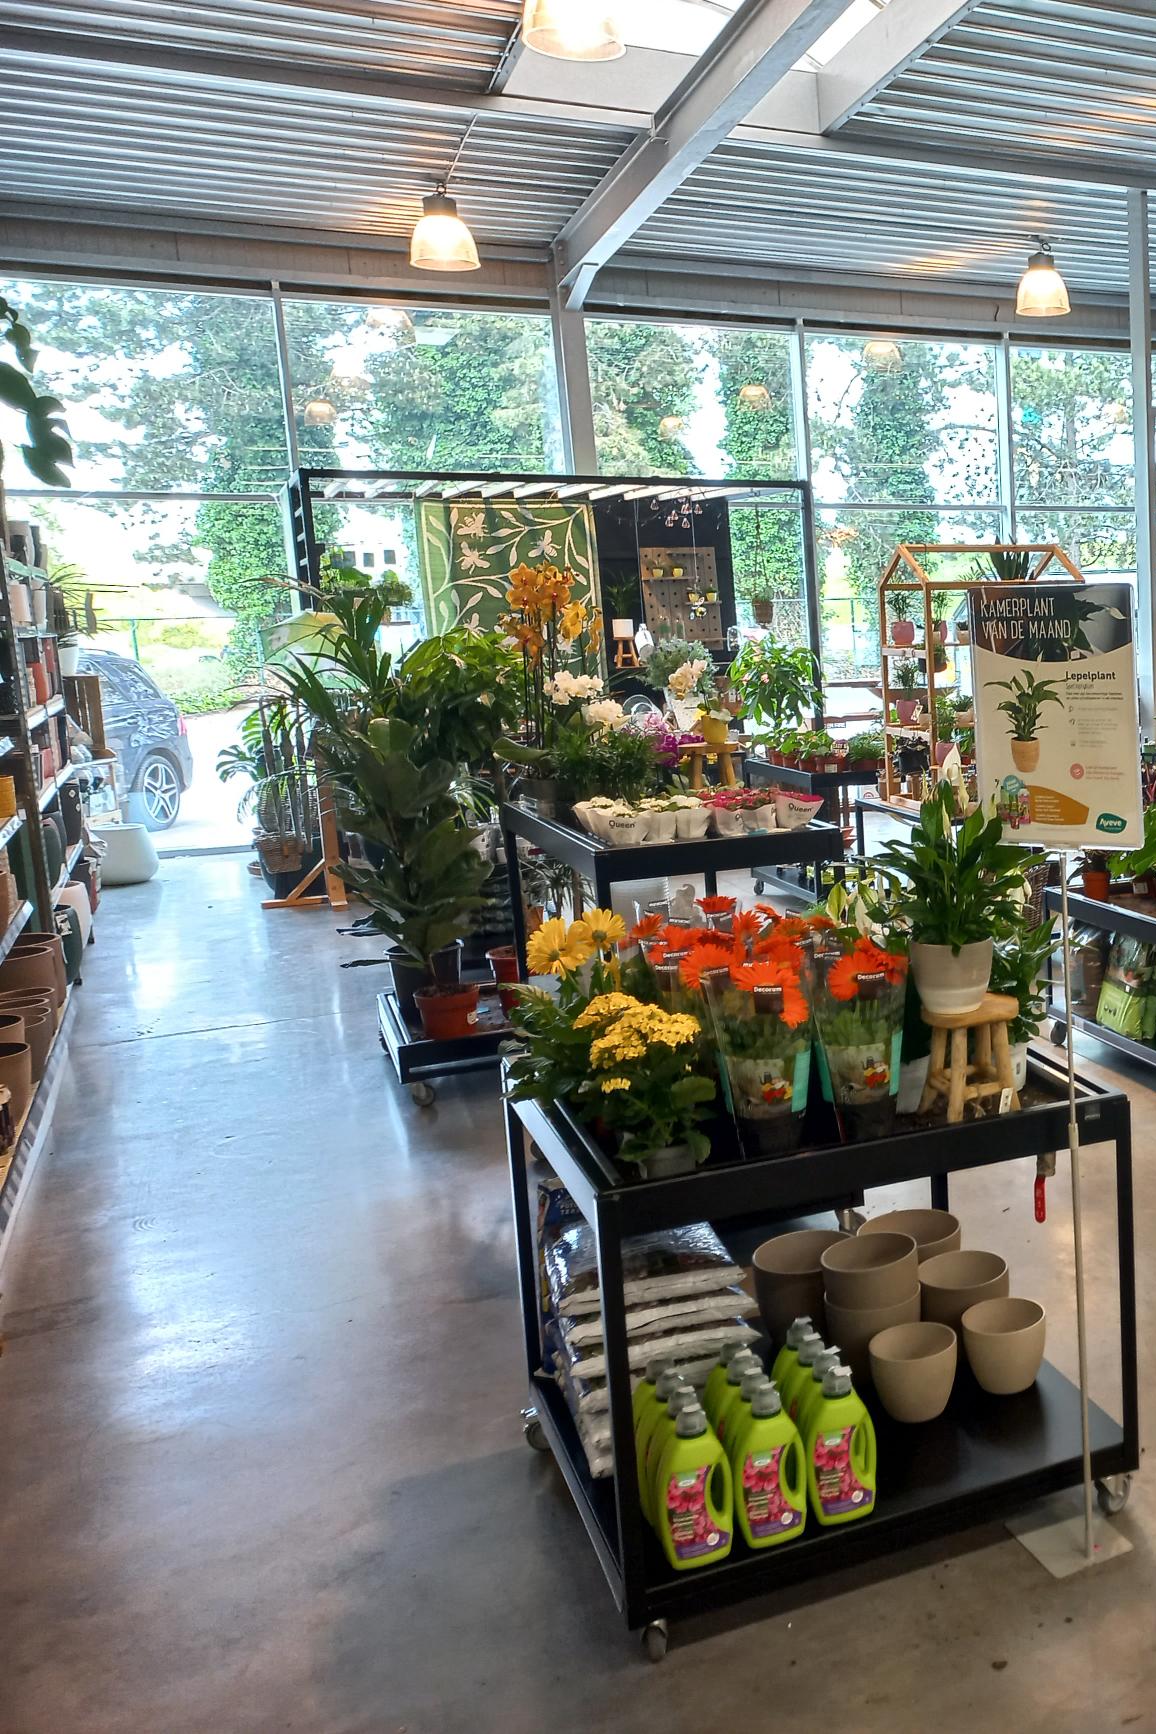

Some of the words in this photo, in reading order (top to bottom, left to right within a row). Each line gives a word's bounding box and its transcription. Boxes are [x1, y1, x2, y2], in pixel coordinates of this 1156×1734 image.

[980, 597, 1055, 618] KAMERPLANT
[981, 619, 1007, 640] VAN
[1010, 620, 1025, 639] DE
[1028, 619, 1071, 639] MAAND
[1065, 671, 1116, 682] Lepelplant
[788, 803, 813, 812] Queen
[609, 820, 635, 829] Queen
[857, 972, 885, 980] Decorum
